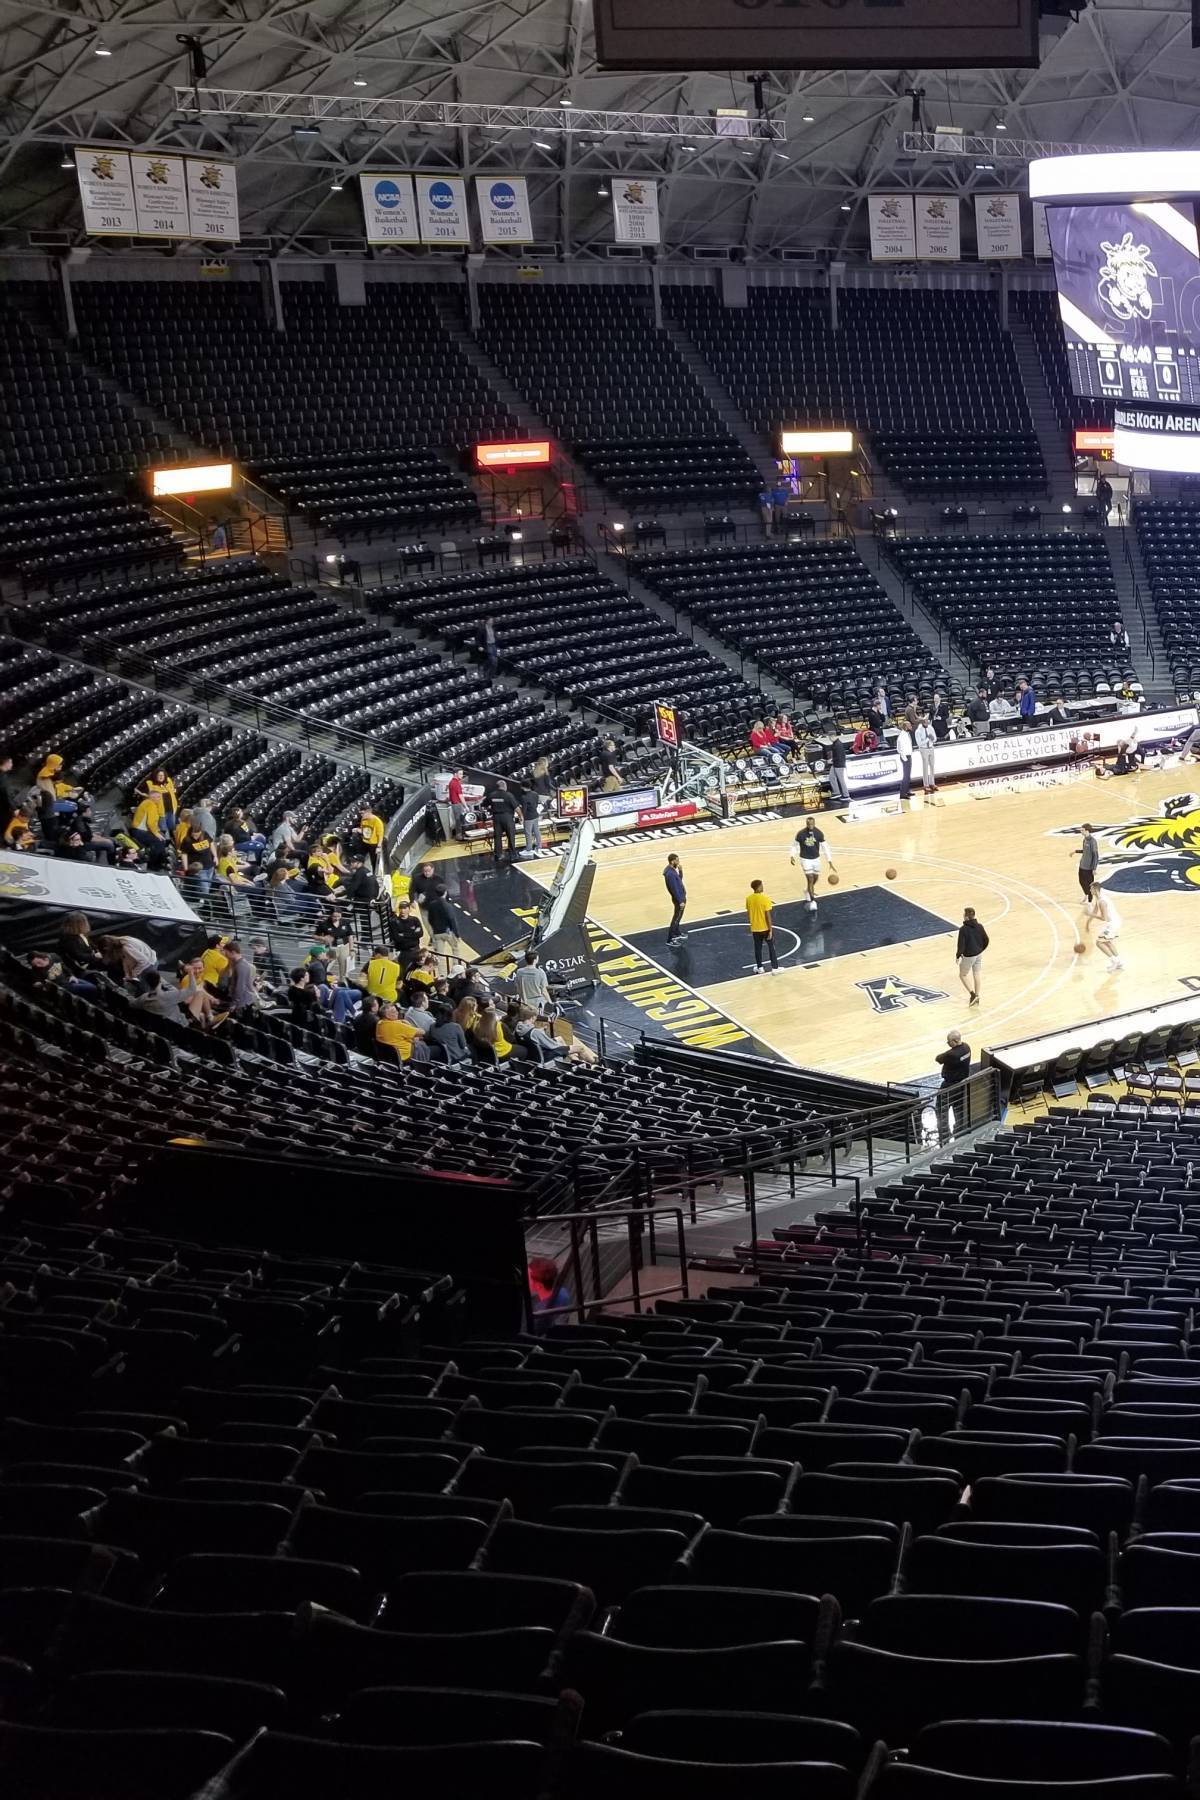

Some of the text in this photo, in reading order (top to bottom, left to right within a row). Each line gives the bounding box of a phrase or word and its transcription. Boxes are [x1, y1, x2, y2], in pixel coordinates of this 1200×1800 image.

[101, 217, 122, 227] 2013
[154, 219, 174, 230] 2014
[205, 223, 225, 233] 2015
[382, 227, 404, 236] 2013
[435, 227, 456, 236] 2014
[498, 227, 518, 236] 2015
[884, 245, 903, 254] 2004
[929, 245, 948, 254] 2005
[991, 244, 1009, 252] 2007
[1106, 362, 1115, 381] 0
[1163, 366, 1171, 384] 0
[1136, 412, 1163, 430] KOCH
[661, 720, 674, 740] 23
[977, 729, 1082, 753] FOR ALL YOUR TIRE
[979, 752, 1009, 764] AUTO
[1012, 745, 1057, 760] SERVICE
[534, 811, 783, 859] GOHOCKERS.COM
[559, 955, 586, 969] STAR
[597, 953, 750, 1049] WICHITA
